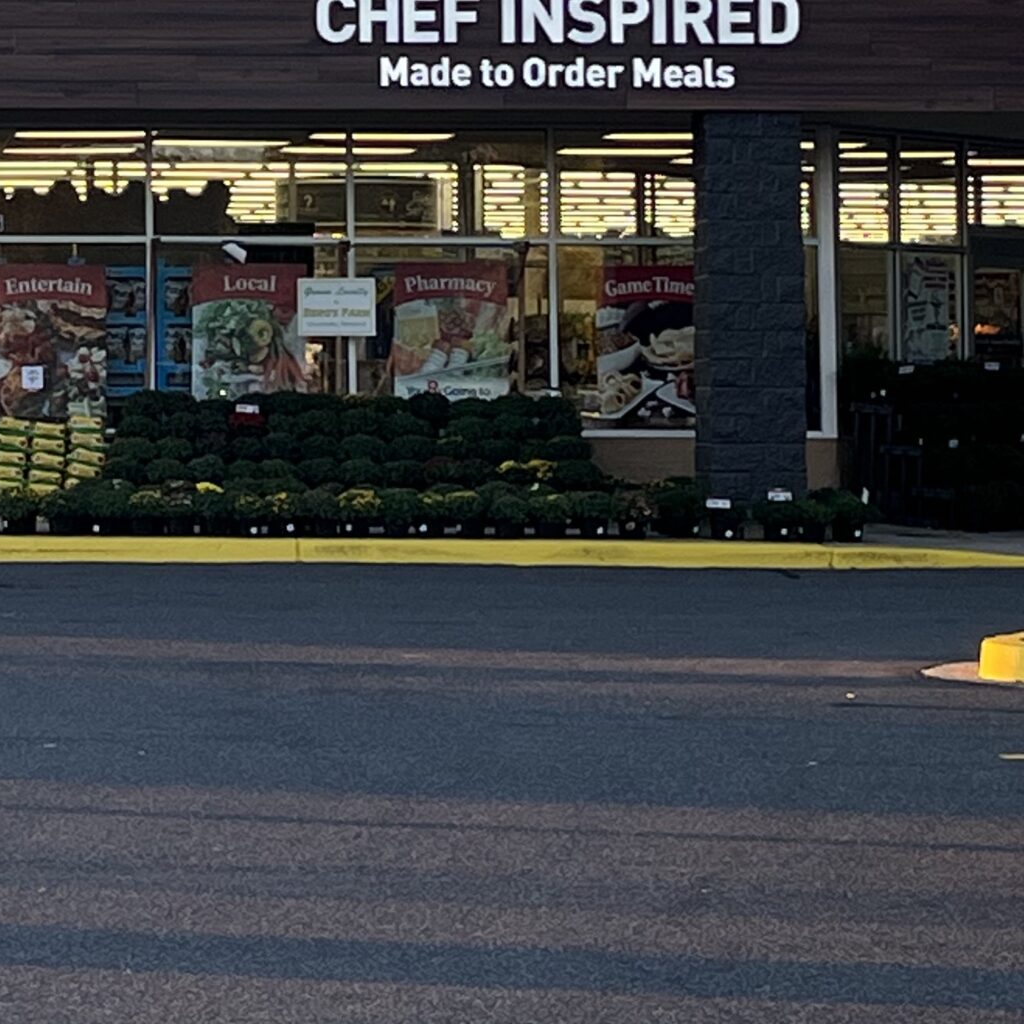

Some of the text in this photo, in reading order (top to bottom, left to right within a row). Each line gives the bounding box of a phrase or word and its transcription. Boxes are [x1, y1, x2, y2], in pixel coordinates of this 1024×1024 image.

[380, 56, 736, 89] Made to Order Meals
[4, 277, 93, 296] Entertain
[223, 275, 277, 292] Local
[404, 275, 496, 297] Pharmacy
[605, 276, 695, 296] Game Time
